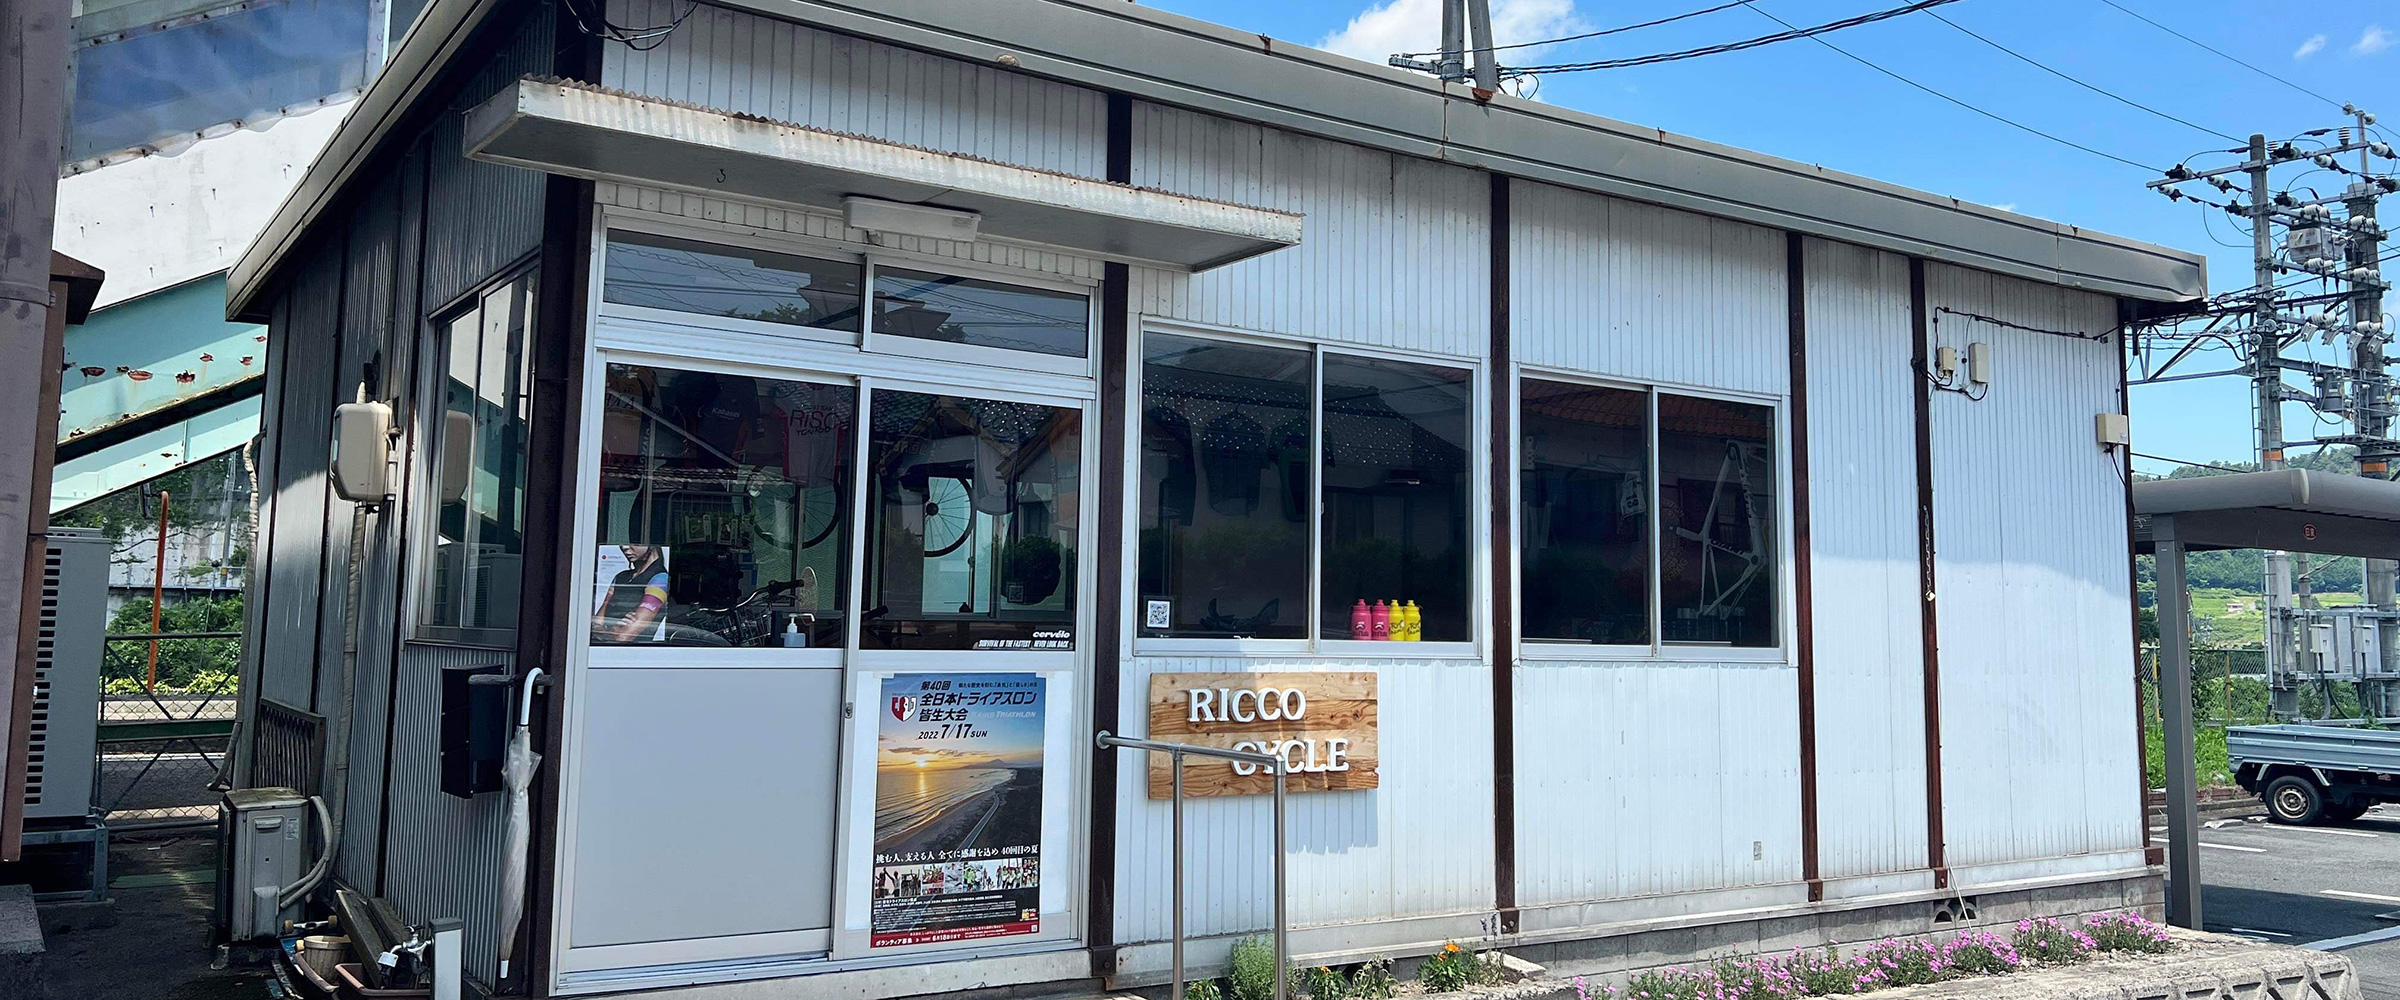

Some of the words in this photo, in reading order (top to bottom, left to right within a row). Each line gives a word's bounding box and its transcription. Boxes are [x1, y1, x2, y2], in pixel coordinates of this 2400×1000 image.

[919, 680, 952, 691] 第40回
[919, 691, 1038, 706] 全日本トライアスロン
[1186, 687, 1307, 724] RICCO
[918, 708, 969, 722] 皆生大会
[995, 711, 1037, 719] TRIATHLON
[918, 731, 939, 740] 2022
[941, 723, 973, 739] 7/17
[970, 730, 988, 738] SUN
